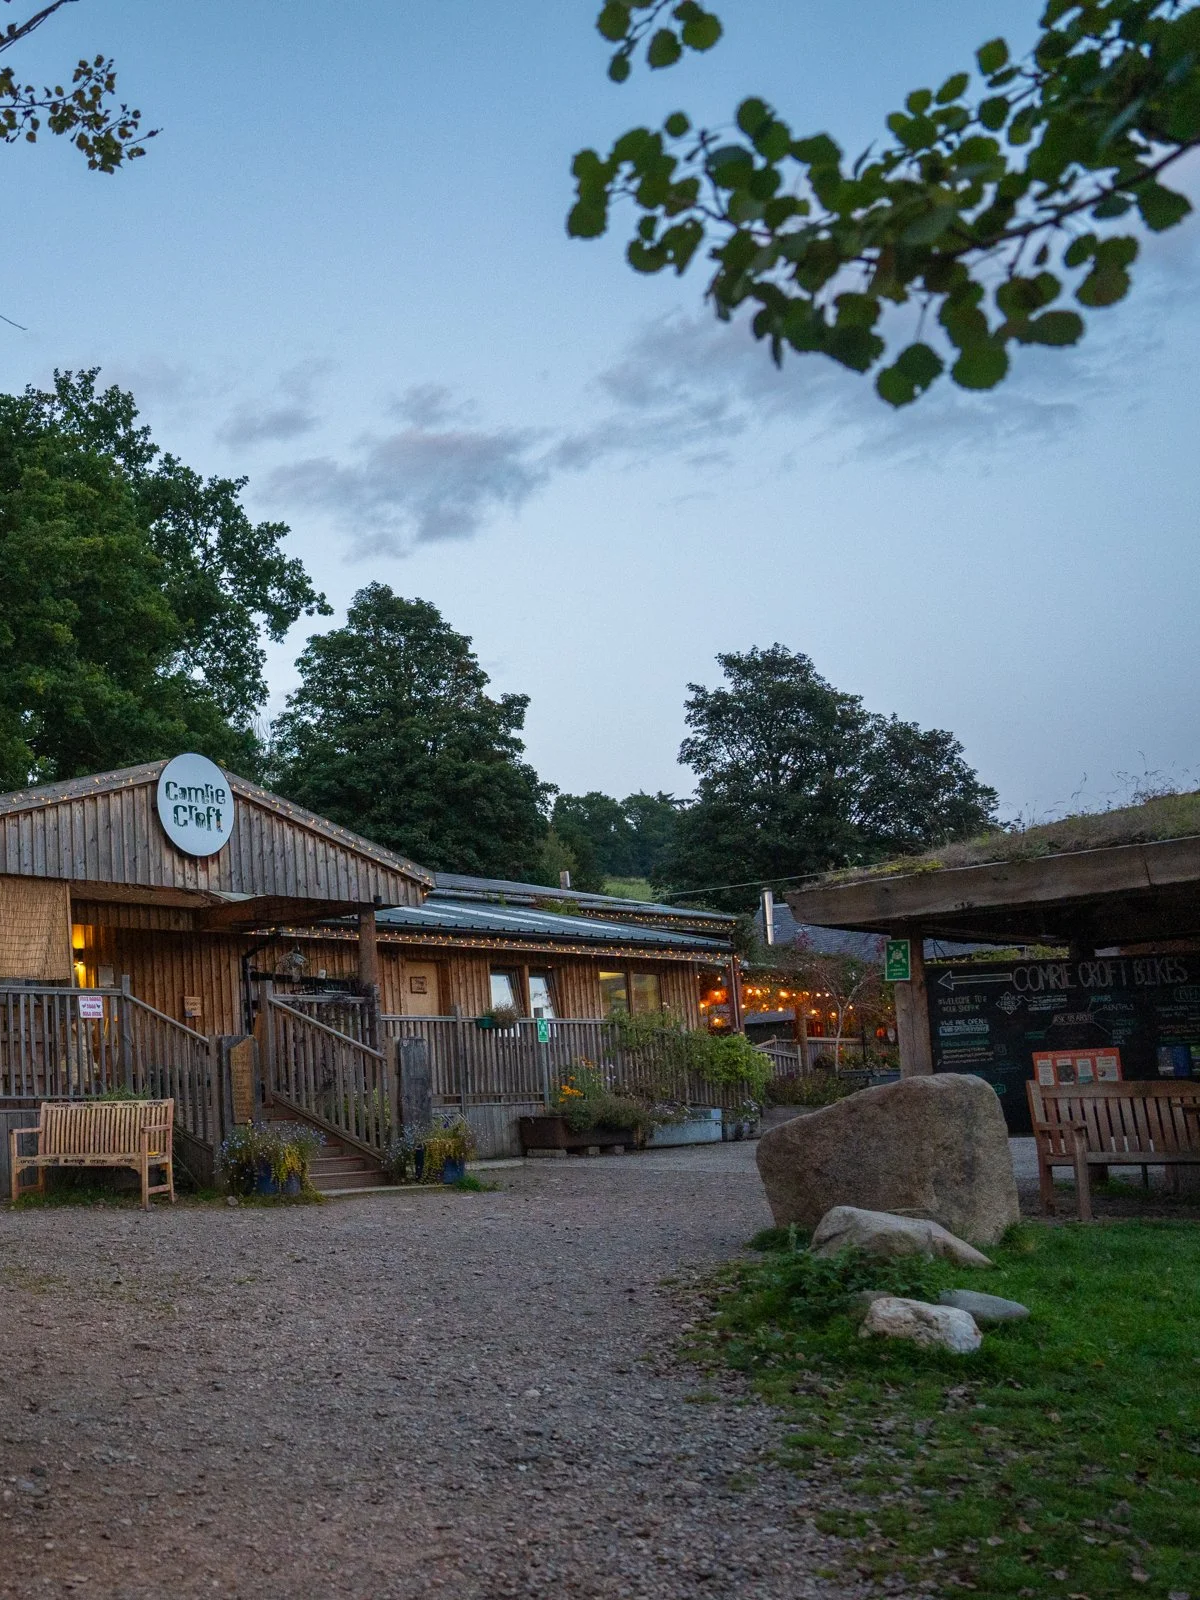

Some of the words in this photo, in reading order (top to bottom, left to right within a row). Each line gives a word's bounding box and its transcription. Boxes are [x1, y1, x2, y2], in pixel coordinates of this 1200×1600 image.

[165, 781, 226, 804] Comrie
[173, 804, 223, 833] Croft
[1012, 963, 1077, 992] COMRIE
[1078, 960, 1128, 988] CROFT
[1132, 957, 1189, 985] BIKES
